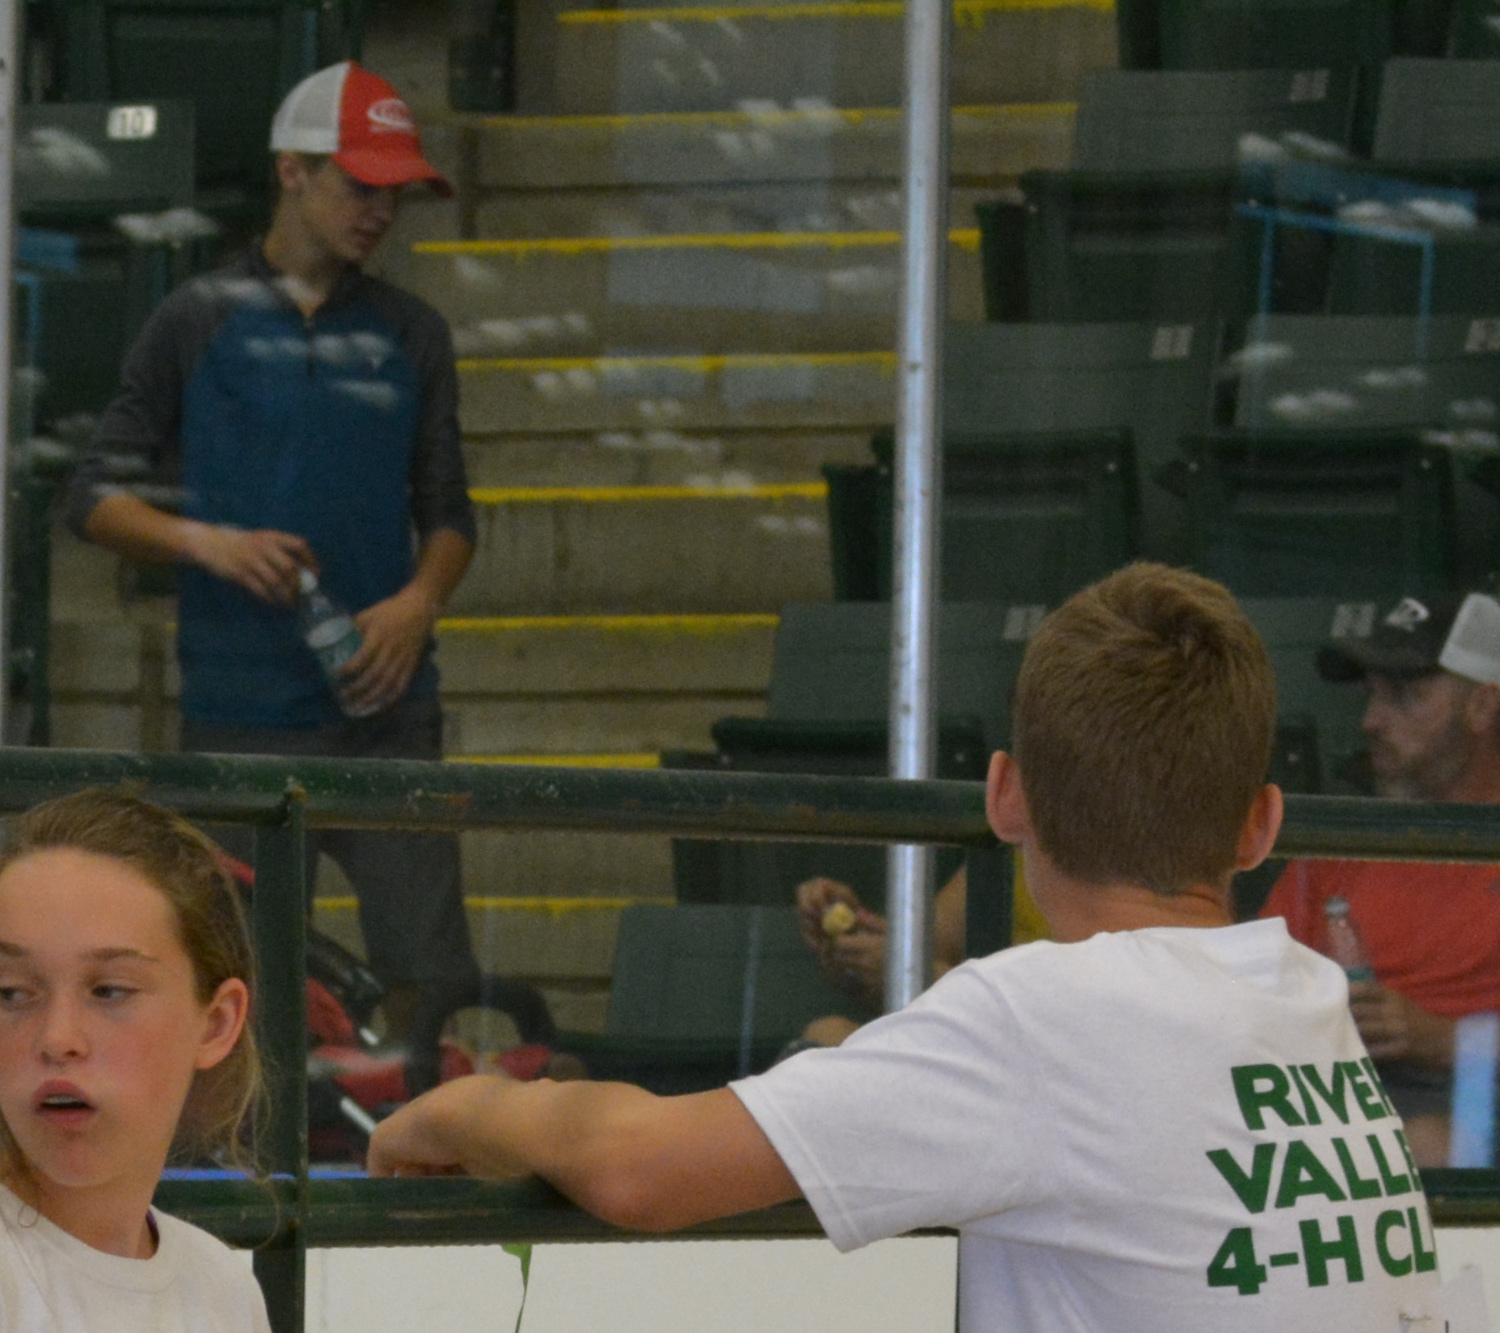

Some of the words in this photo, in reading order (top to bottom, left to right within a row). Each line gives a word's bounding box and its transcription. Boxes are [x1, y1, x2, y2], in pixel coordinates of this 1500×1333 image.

[121, 110, 146, 136] 10
[1205, 1129, 1424, 1214] VALL
[1206, 1214, 1365, 1296] 4-H
[1374, 1206, 1437, 1278] CL
